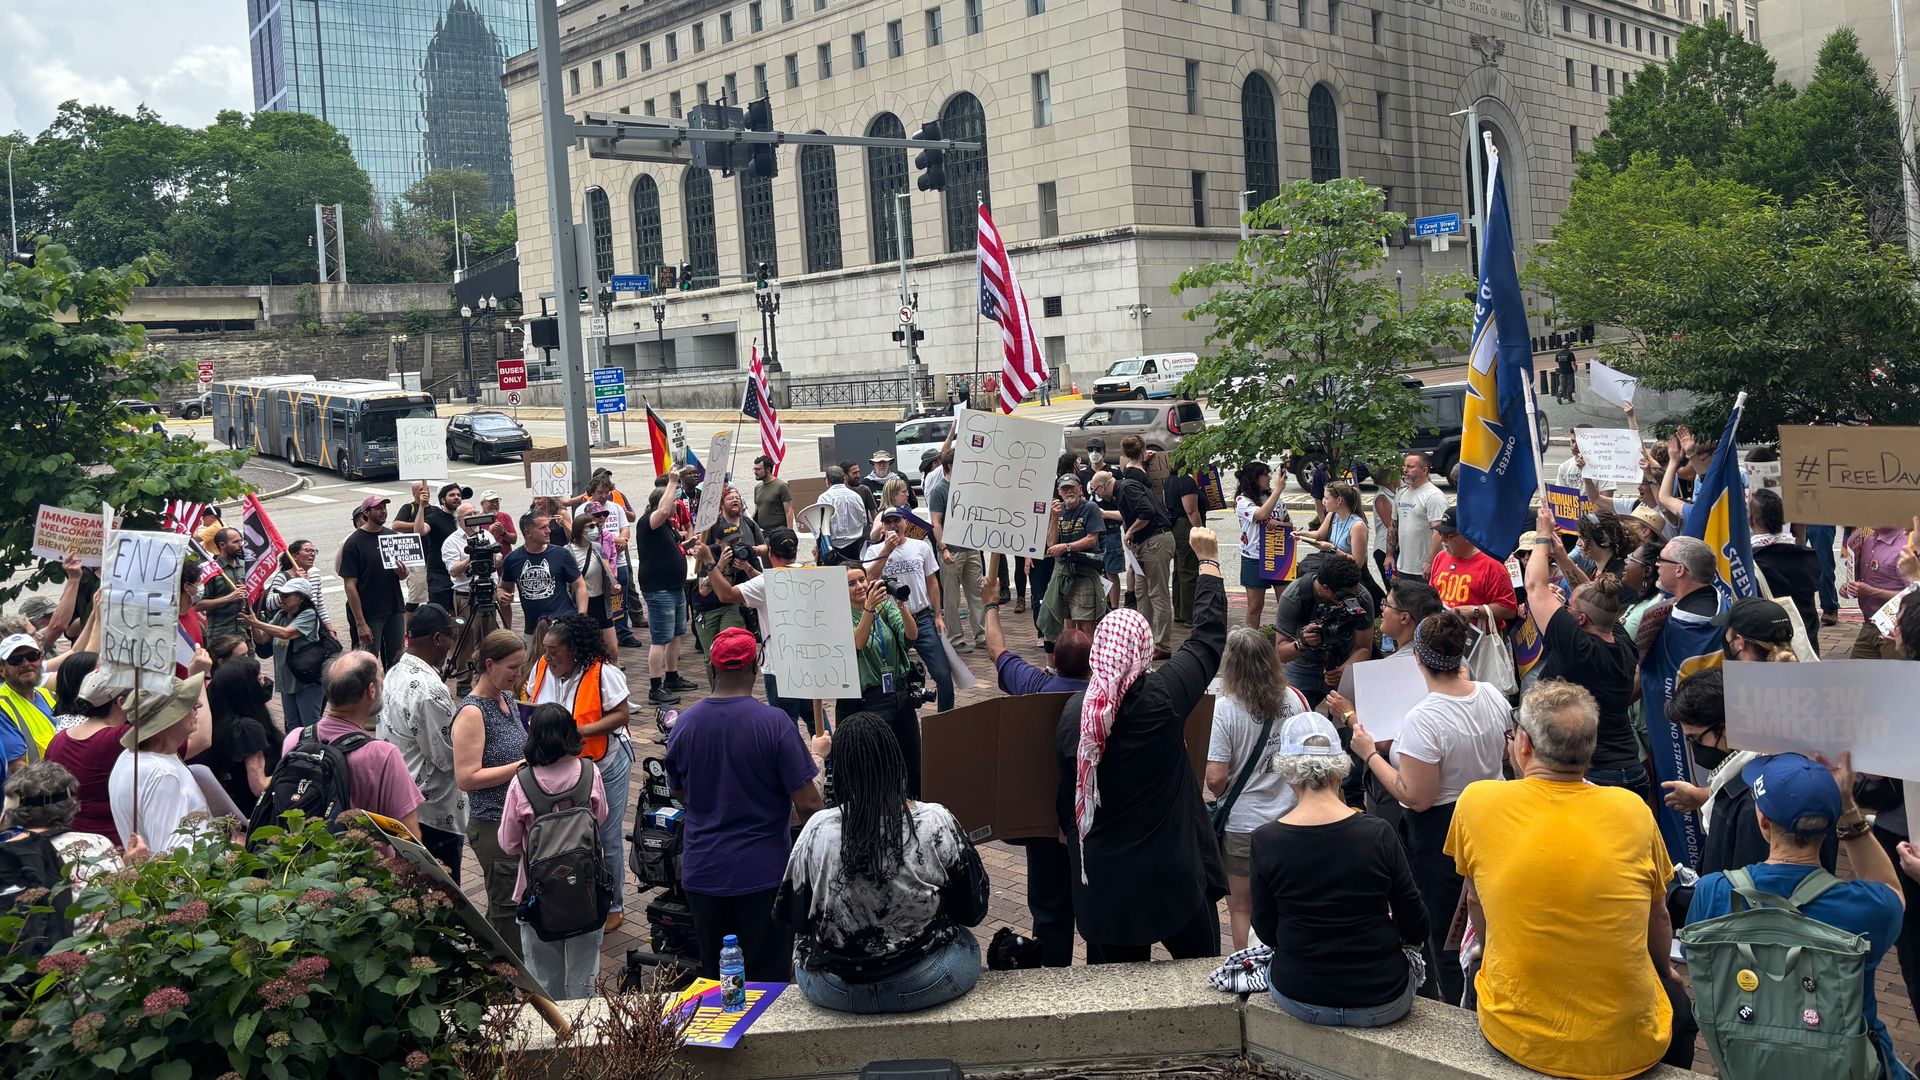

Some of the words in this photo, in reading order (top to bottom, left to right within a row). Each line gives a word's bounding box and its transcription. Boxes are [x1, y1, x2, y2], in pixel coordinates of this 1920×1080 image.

[1470, 2, 1488, 15] STATES
[499, 367, 524, 375] BUSES
[503, 376, 522, 384] ONLY
[404, 425, 438, 439] FREE
[400, 440, 439, 454] DAVID
[404, 453, 444, 467] HUERTA
[958, 460, 1037, 491] ICE
[532, 479, 570, 495] KINGS!
[950, 490, 1027, 528] RAIDS
[41, 510, 118, 529] IMMIGRANS
[40, 522, 91, 537] WELCOME
[1264, 532, 1275, 560] HUMAN
[1275, 527, 1285, 556] ILLEGAL
[113, 538, 177, 583] END
[1264, 560, 1275, 572] NO
[1437, 571, 1472, 602] 506
[774, 608, 828, 628] ICE
[105, 631, 166, 670] RAIDS
[778, 633, 844, 661] RAIDS
[1740, 1006, 1752, 1018] PA
[694, 1030, 727, 1044] IS
